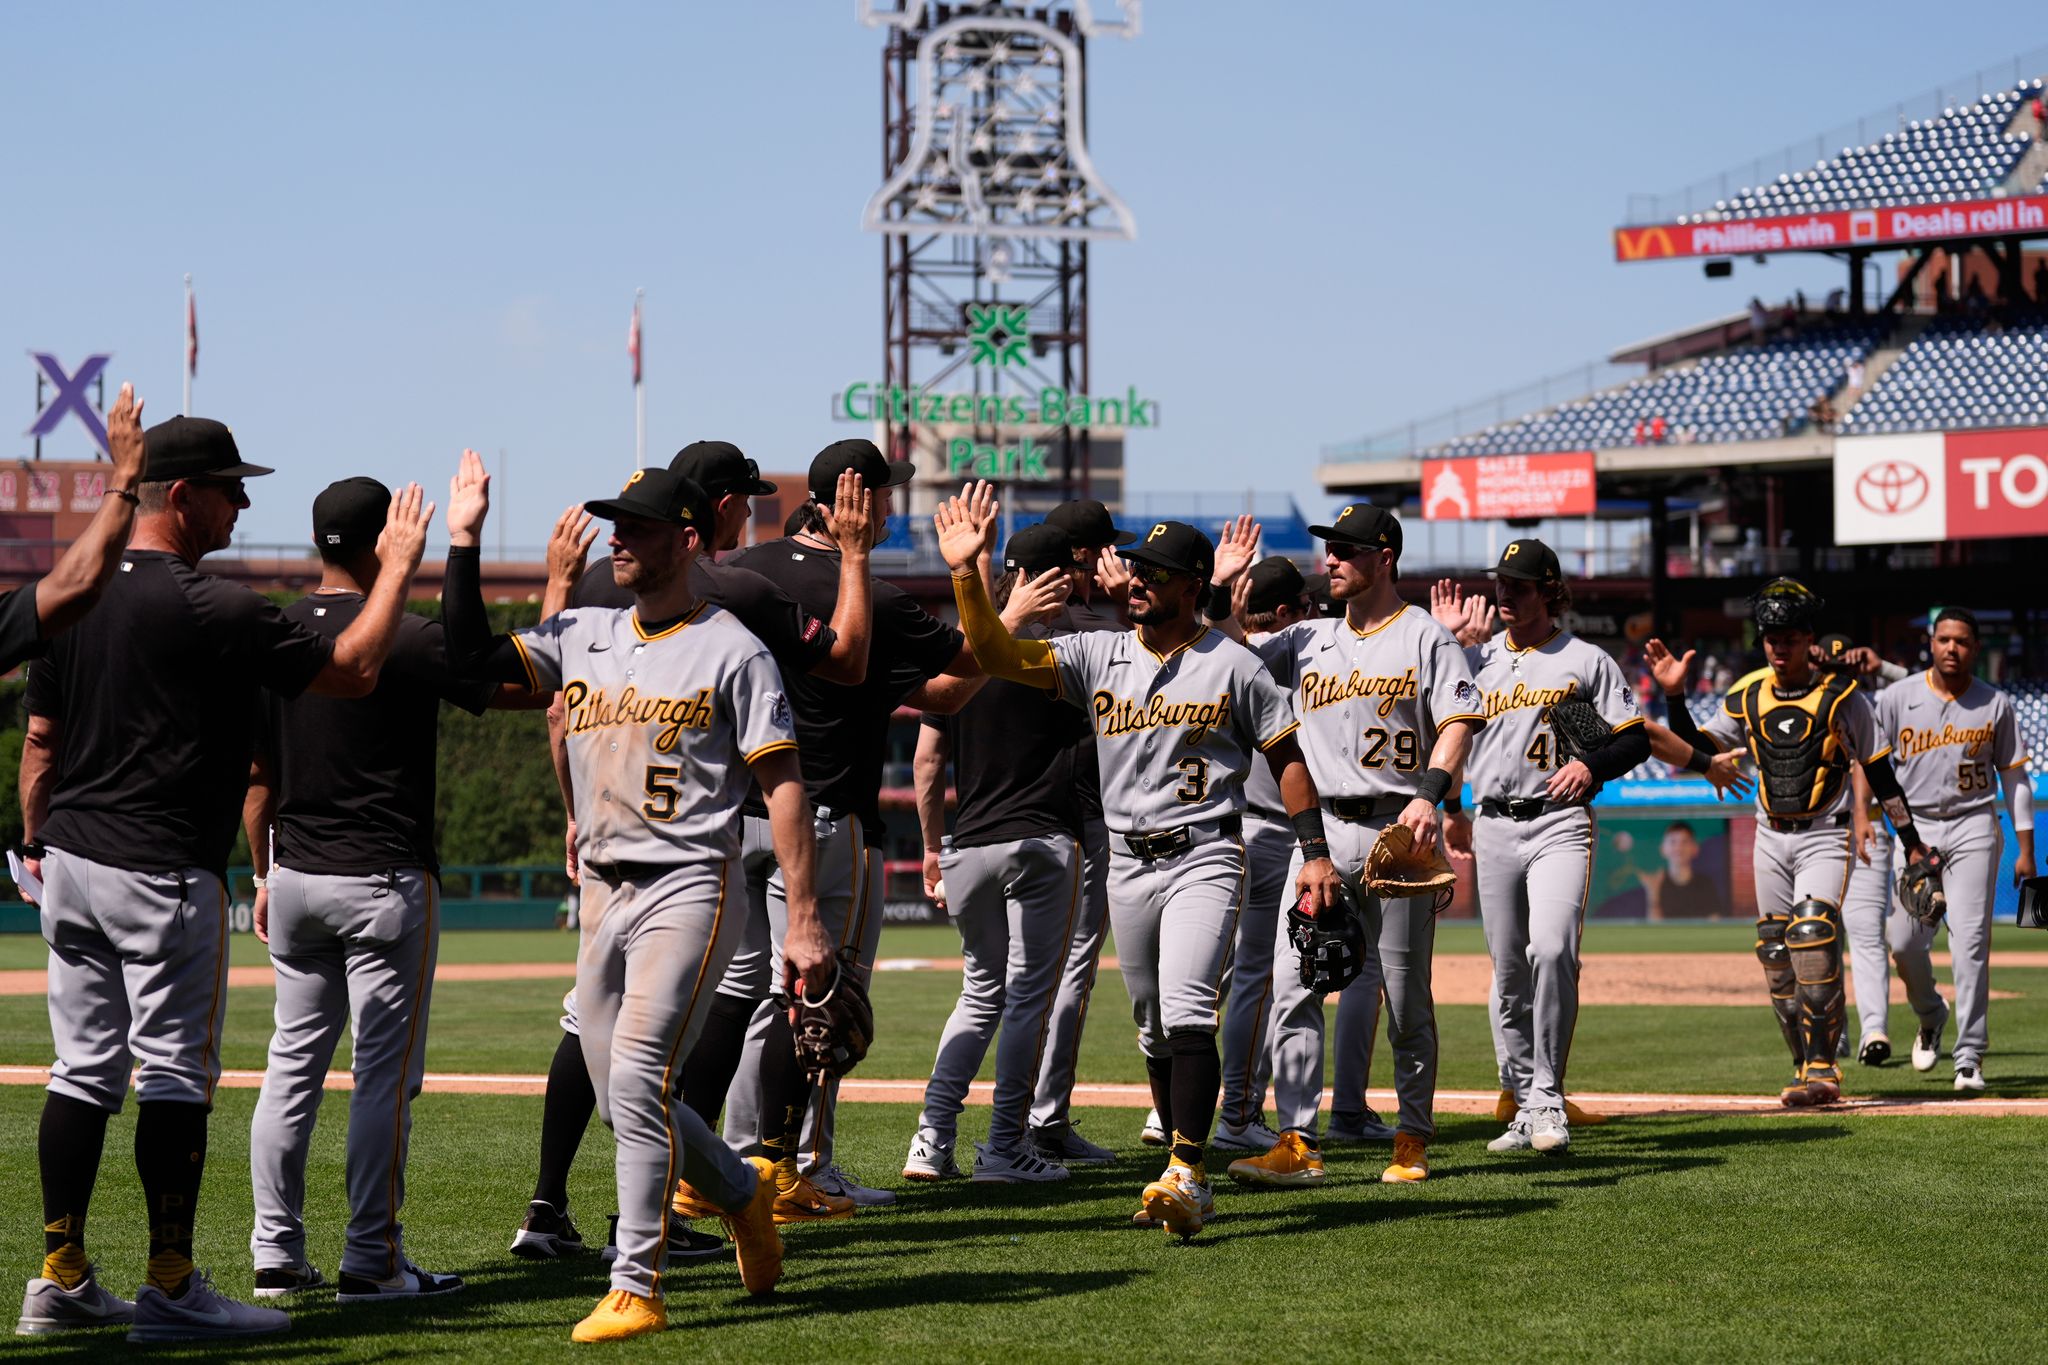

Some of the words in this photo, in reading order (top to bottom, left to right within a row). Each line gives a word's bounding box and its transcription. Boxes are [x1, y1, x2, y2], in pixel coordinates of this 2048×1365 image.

[1692, 223, 1783, 254] Phillies
[1788, 217, 1835, 246] win
[1891, 209, 1967, 238] Deals
[1970, 203, 2013, 232] roll
[2018, 200, 2044, 226] in
[843, 381, 1027, 426] Citizens
[1038, 386, 1151, 426] Bank
[950, 437, 1048, 478] Park
[1960, 453, 2048, 510] TO
[1148, 524, 1167, 542] P
[1337, 506, 1354, 522] P
[1504, 544, 1519, 560] P
[1832, 640, 1843, 655] P
[1301, 666, 1418, 719] Pittsburgh
[563, 679, 716, 754] Pittsburgh
[1093, 689, 1231, 747] Pittsburgh
[1360, 727, 1419, 772] 29
[1899, 721, 1995, 760] Pittsburgh
[641, 764, 681, 822] 5
[1175, 756, 1210, 803] 3
[1958, 762, 1990, 791] 55
